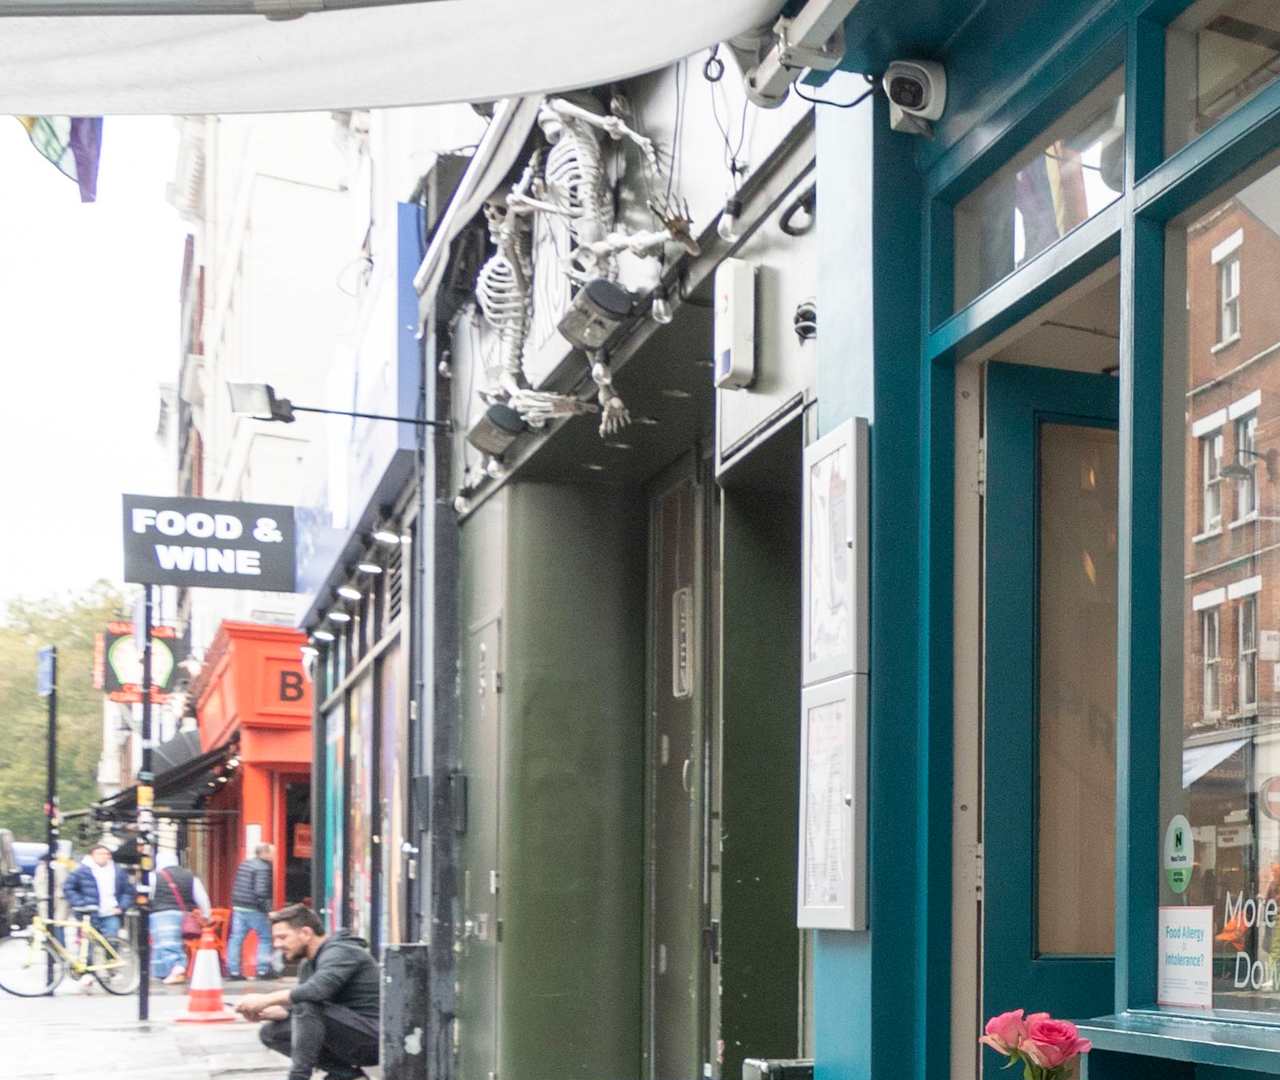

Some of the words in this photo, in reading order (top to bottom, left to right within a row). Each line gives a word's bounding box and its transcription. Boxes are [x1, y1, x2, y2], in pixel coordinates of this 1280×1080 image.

[132, 508, 243, 540] FOOD
[252, 517, 284, 543] &
[154, 544, 262, 576] WINE
[1223, 890, 1278, 929] More
[1165, 926, 1180, 940] Food
[1181, 926, 1205, 943] Allergy
